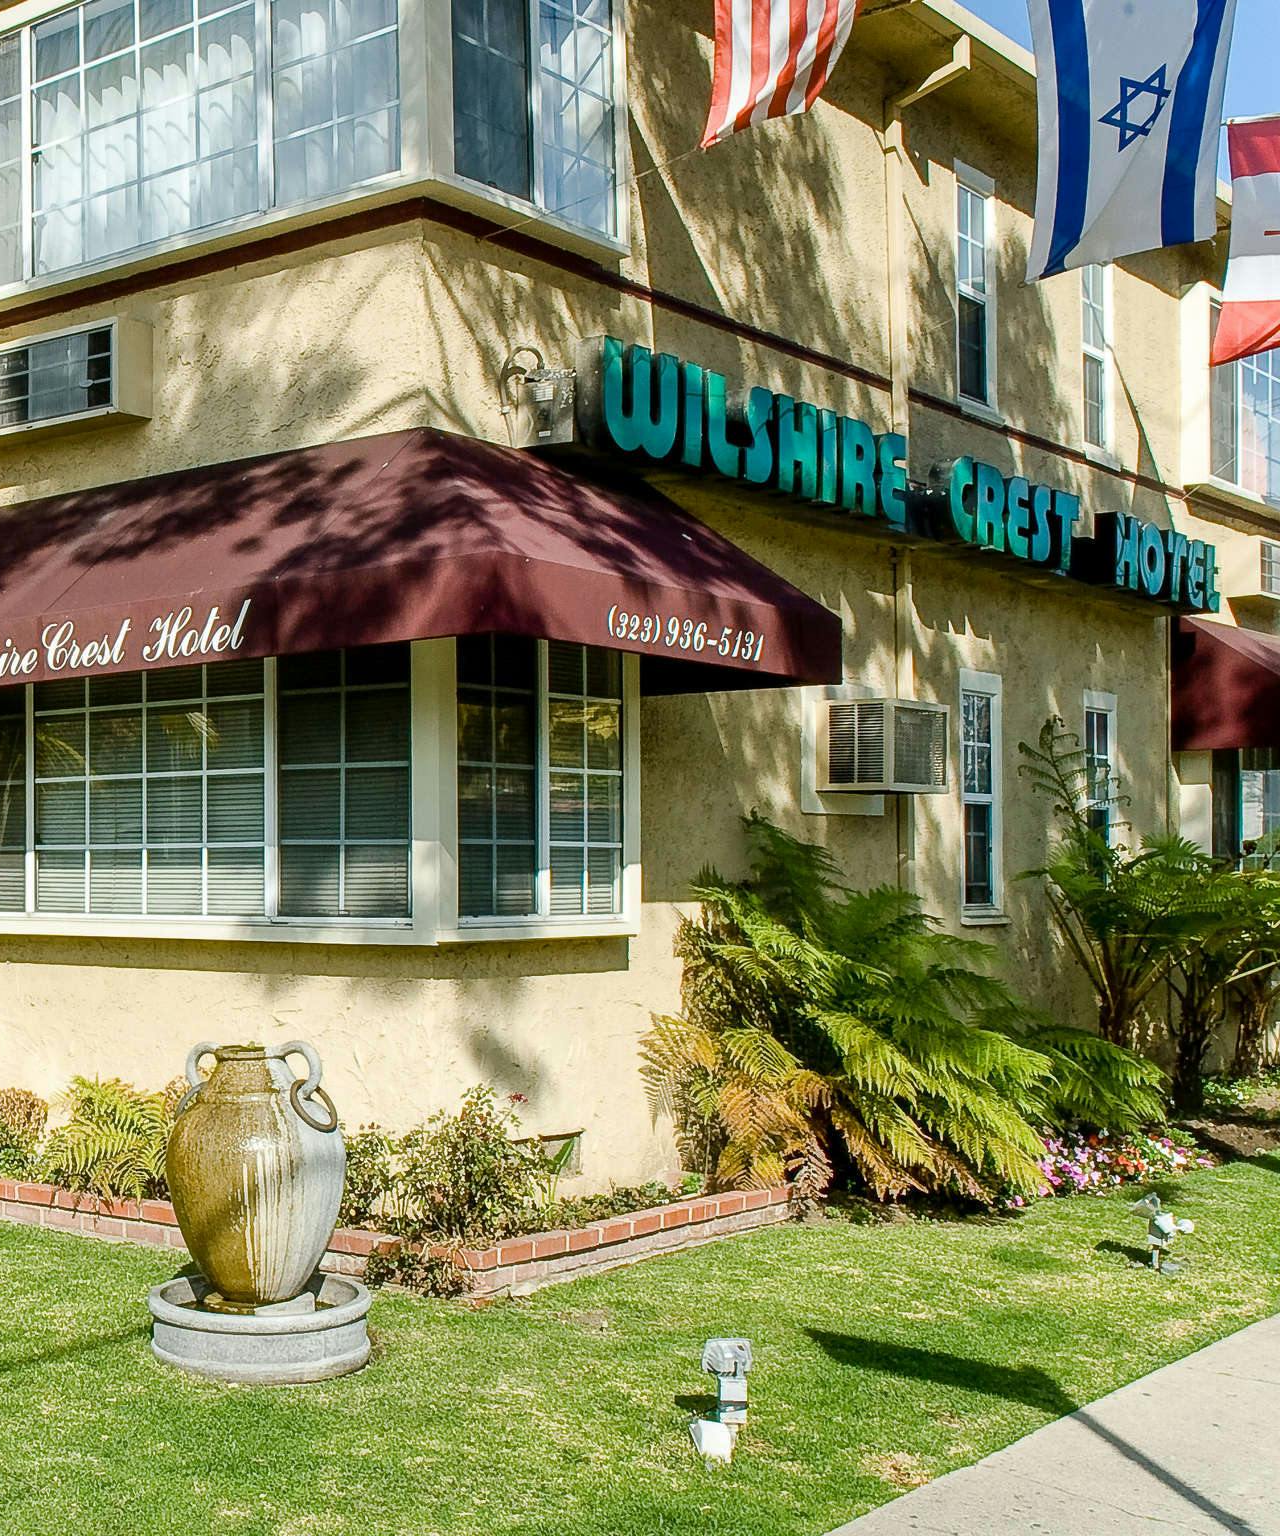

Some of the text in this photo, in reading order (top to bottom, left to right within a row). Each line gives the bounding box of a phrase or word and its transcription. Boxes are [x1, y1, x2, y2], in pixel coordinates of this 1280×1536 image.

[603, 335, 1220, 613] WILSHIRE CREST HOTEL
[41, 618, 132, 671] Crest
[142, 598, 252, 662] Hotel
[608, 604, 764, 662] (323) 936-5131
